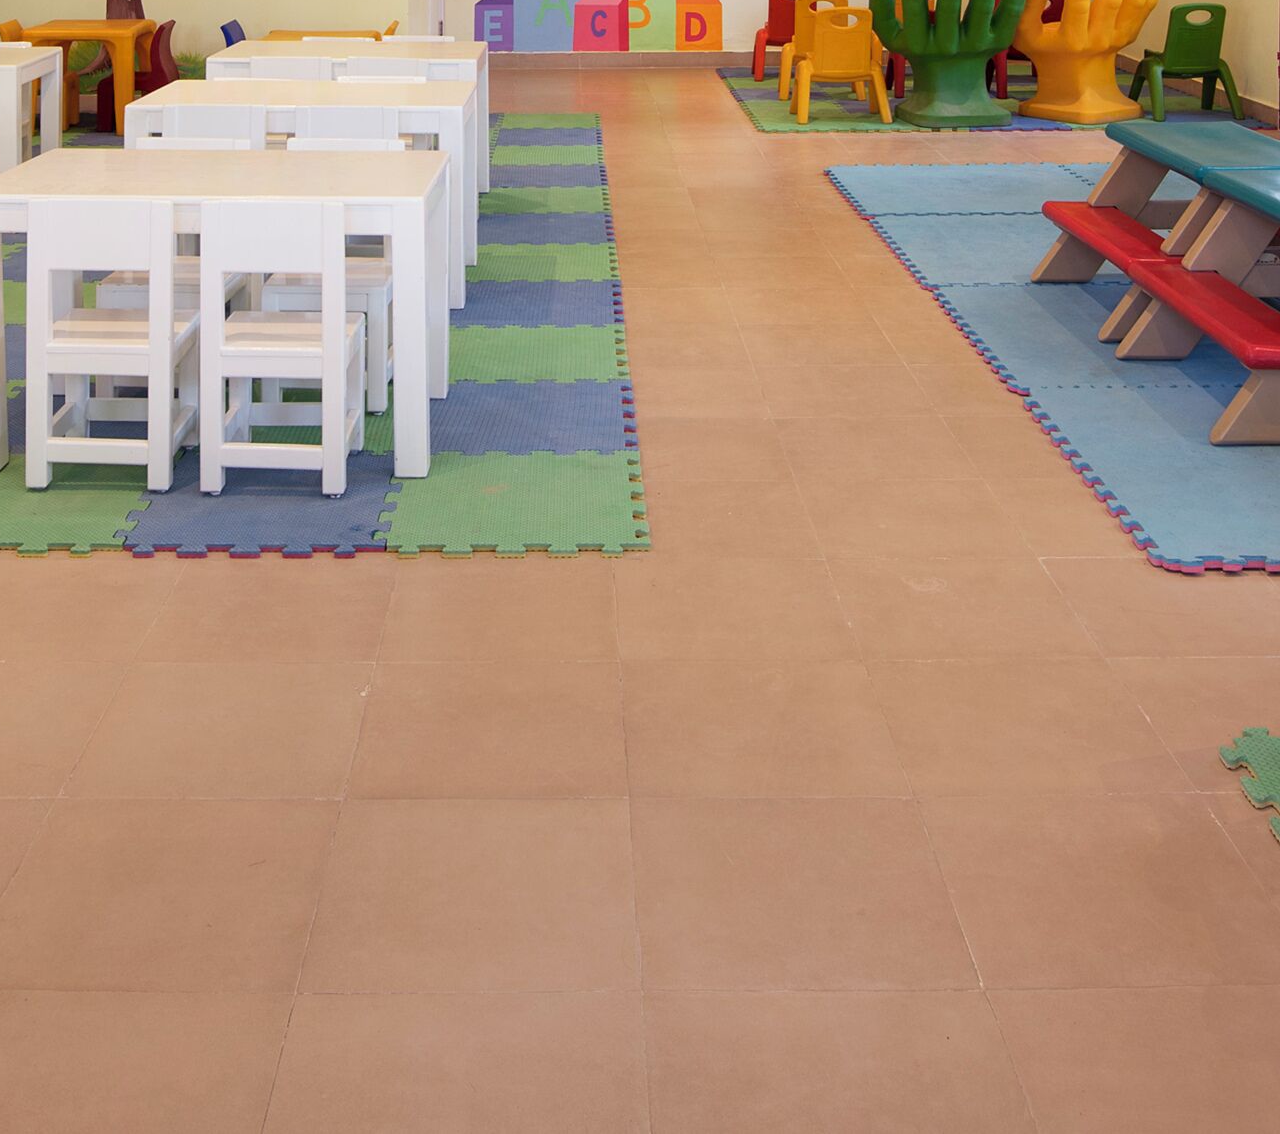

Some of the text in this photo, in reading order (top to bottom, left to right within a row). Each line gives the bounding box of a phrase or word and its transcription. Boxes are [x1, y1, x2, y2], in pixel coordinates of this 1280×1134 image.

[483, 9, 503, 42] E
[590, 10, 608, 38] C
[684, 12, 708, 42] D
